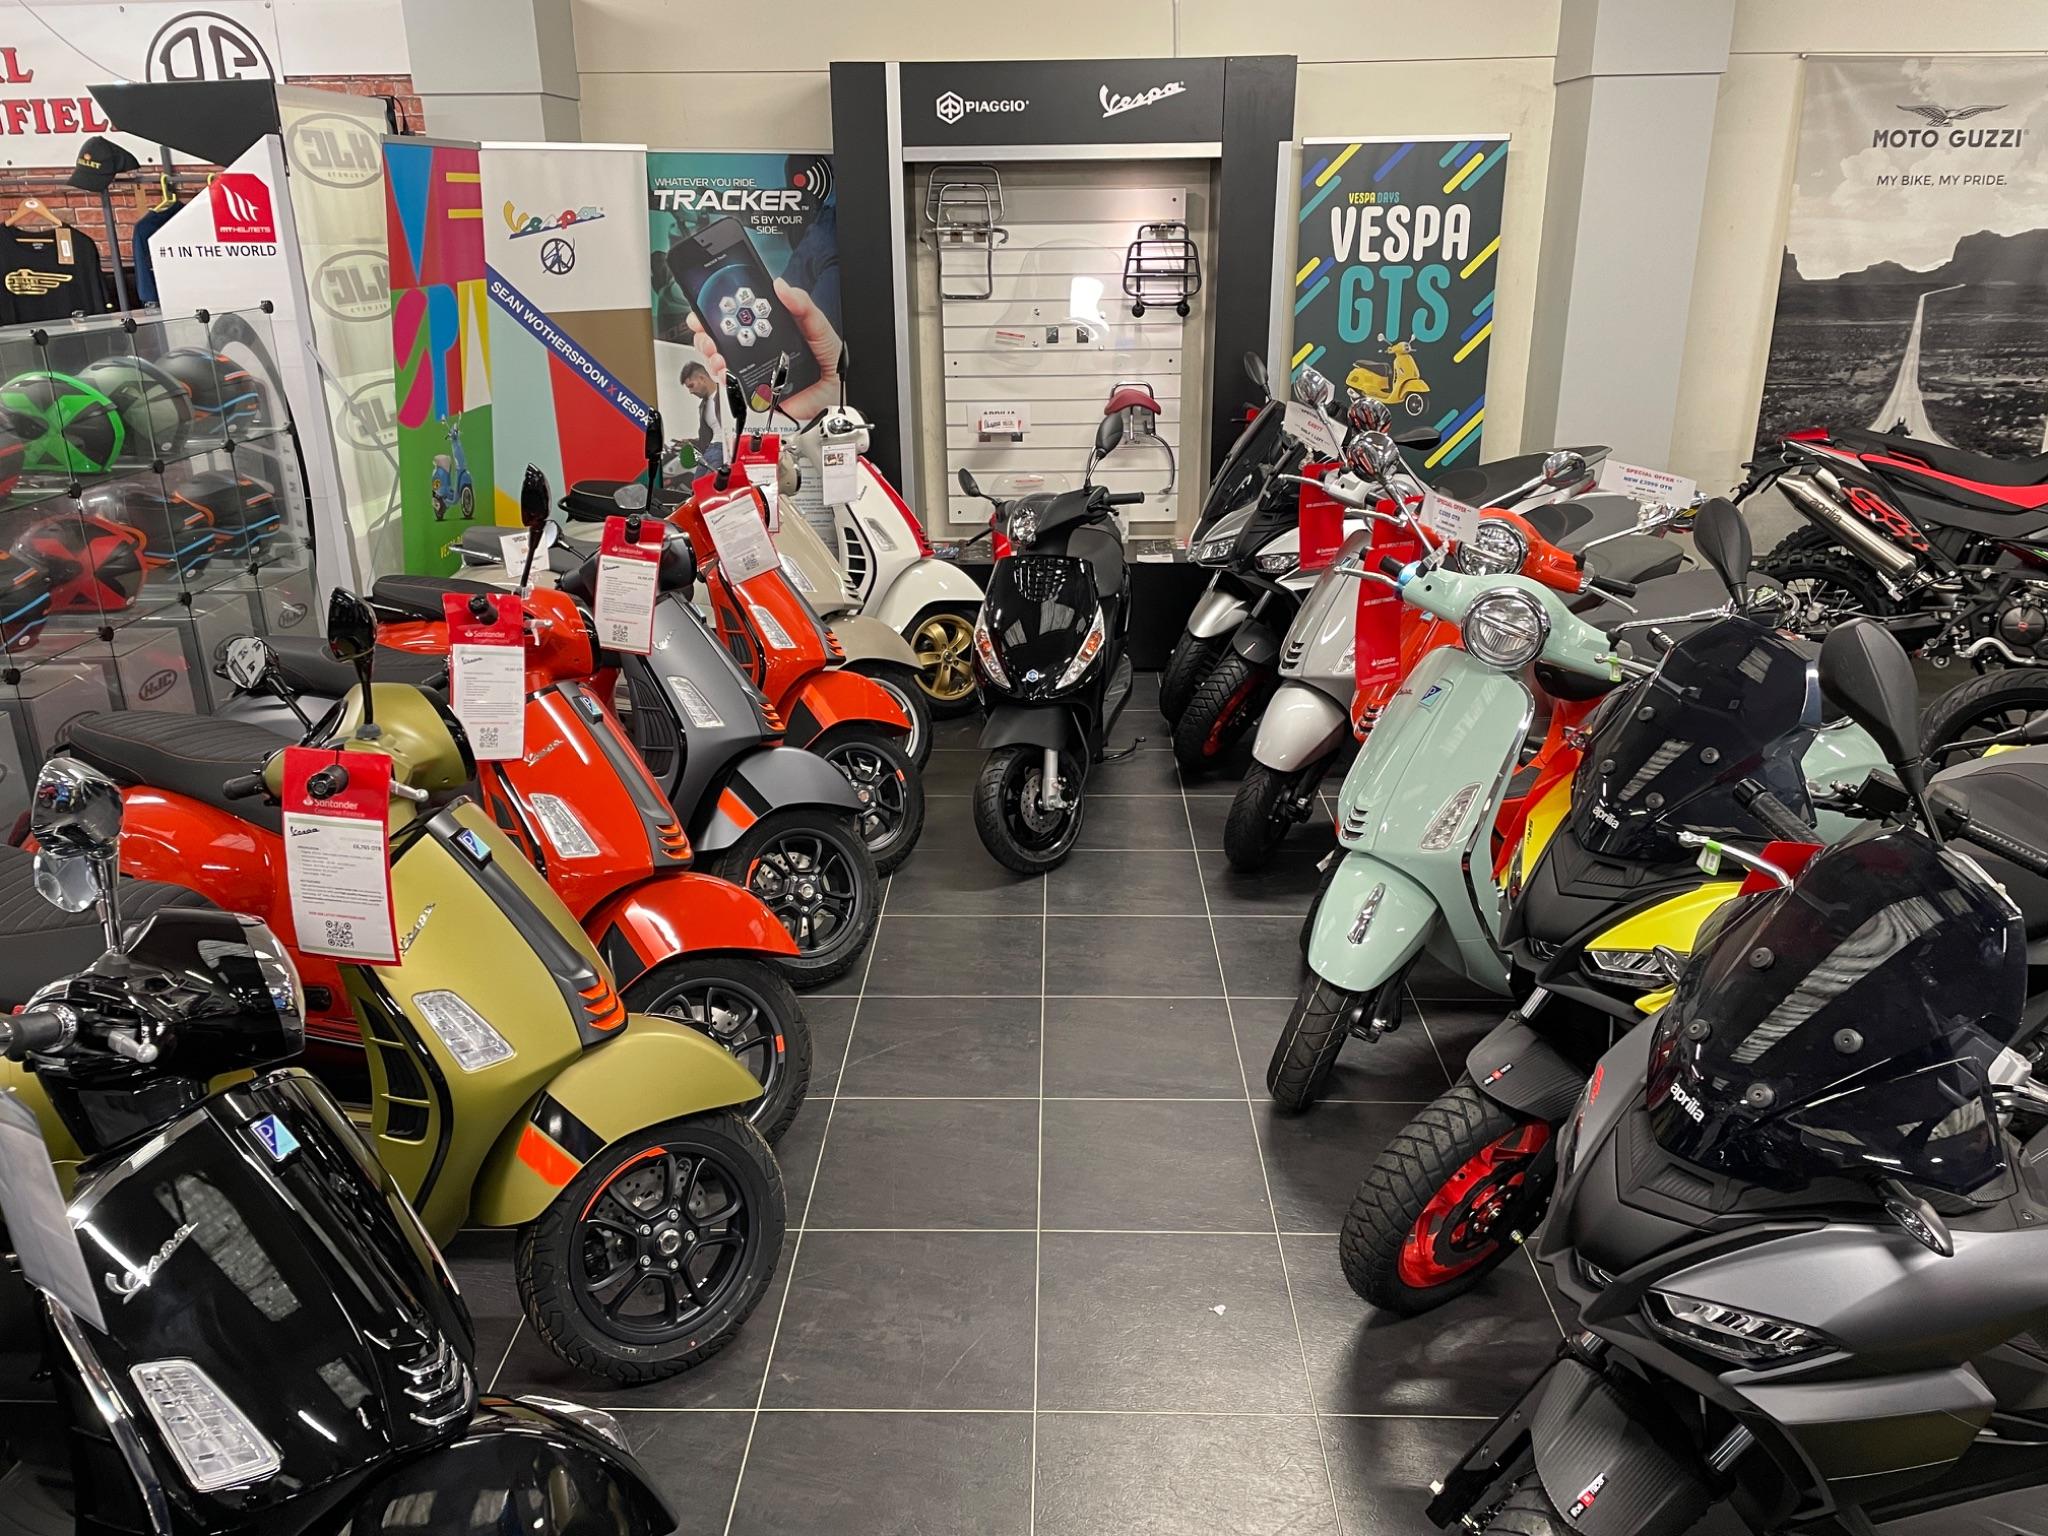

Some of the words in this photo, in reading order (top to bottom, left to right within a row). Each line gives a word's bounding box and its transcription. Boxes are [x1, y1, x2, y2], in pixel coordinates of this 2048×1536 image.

[0, 47, 34, 83] L
[965, 100, 1026, 112] PIAGGIO
[1099, 80, 1186, 118] Vespa
[0, 97, 120, 134] FIEL
[1872, 129, 1939, 148] MOTO
[1949, 129, 2022, 148] GUZZI
[654, 178, 709, 187] WHATEVER
[711, 178, 732, 187] YOU
[1876, 175, 1897, 186] MY
[1901, 175, 1935, 187] BIKE,
[1938, 175, 1960, 186] MY
[1963, 175, 2008, 186] PRIDE.
[653, 189, 803, 211] TRACKER
[1348, 192, 1376, 204] VESPA
[1376, 192, 1400, 204] DAYS
[503, 200, 605, 240] Vespa
[751, 215, 760, 225] IS
[761, 215, 774, 225] BY
[776, 215, 803, 225] YOUR
[1330, 203, 1471, 263] VESPA
[159, 245, 175, 258] #1
[178, 245, 192, 258] IN
[199, 245, 222, 258] THE
[225, 245, 277, 257] WORLD
[1337, 263, 1451, 343] GTS
[490, 281, 524, 313] SEAN
[523, 308, 609, 388] WOTHERSPOON
[616, 391, 652, 426] VESPA
[1626, 468, 1652, 478] SPECIAL
[1654, 474, 1675, 483] OFFER
[1809, 498, 1842, 523] aprilia
[144, 672, 172, 697] HJC
[1592, 806, 1620, 830] aprilia
[1670, 1082, 1705, 1123] aprilia
